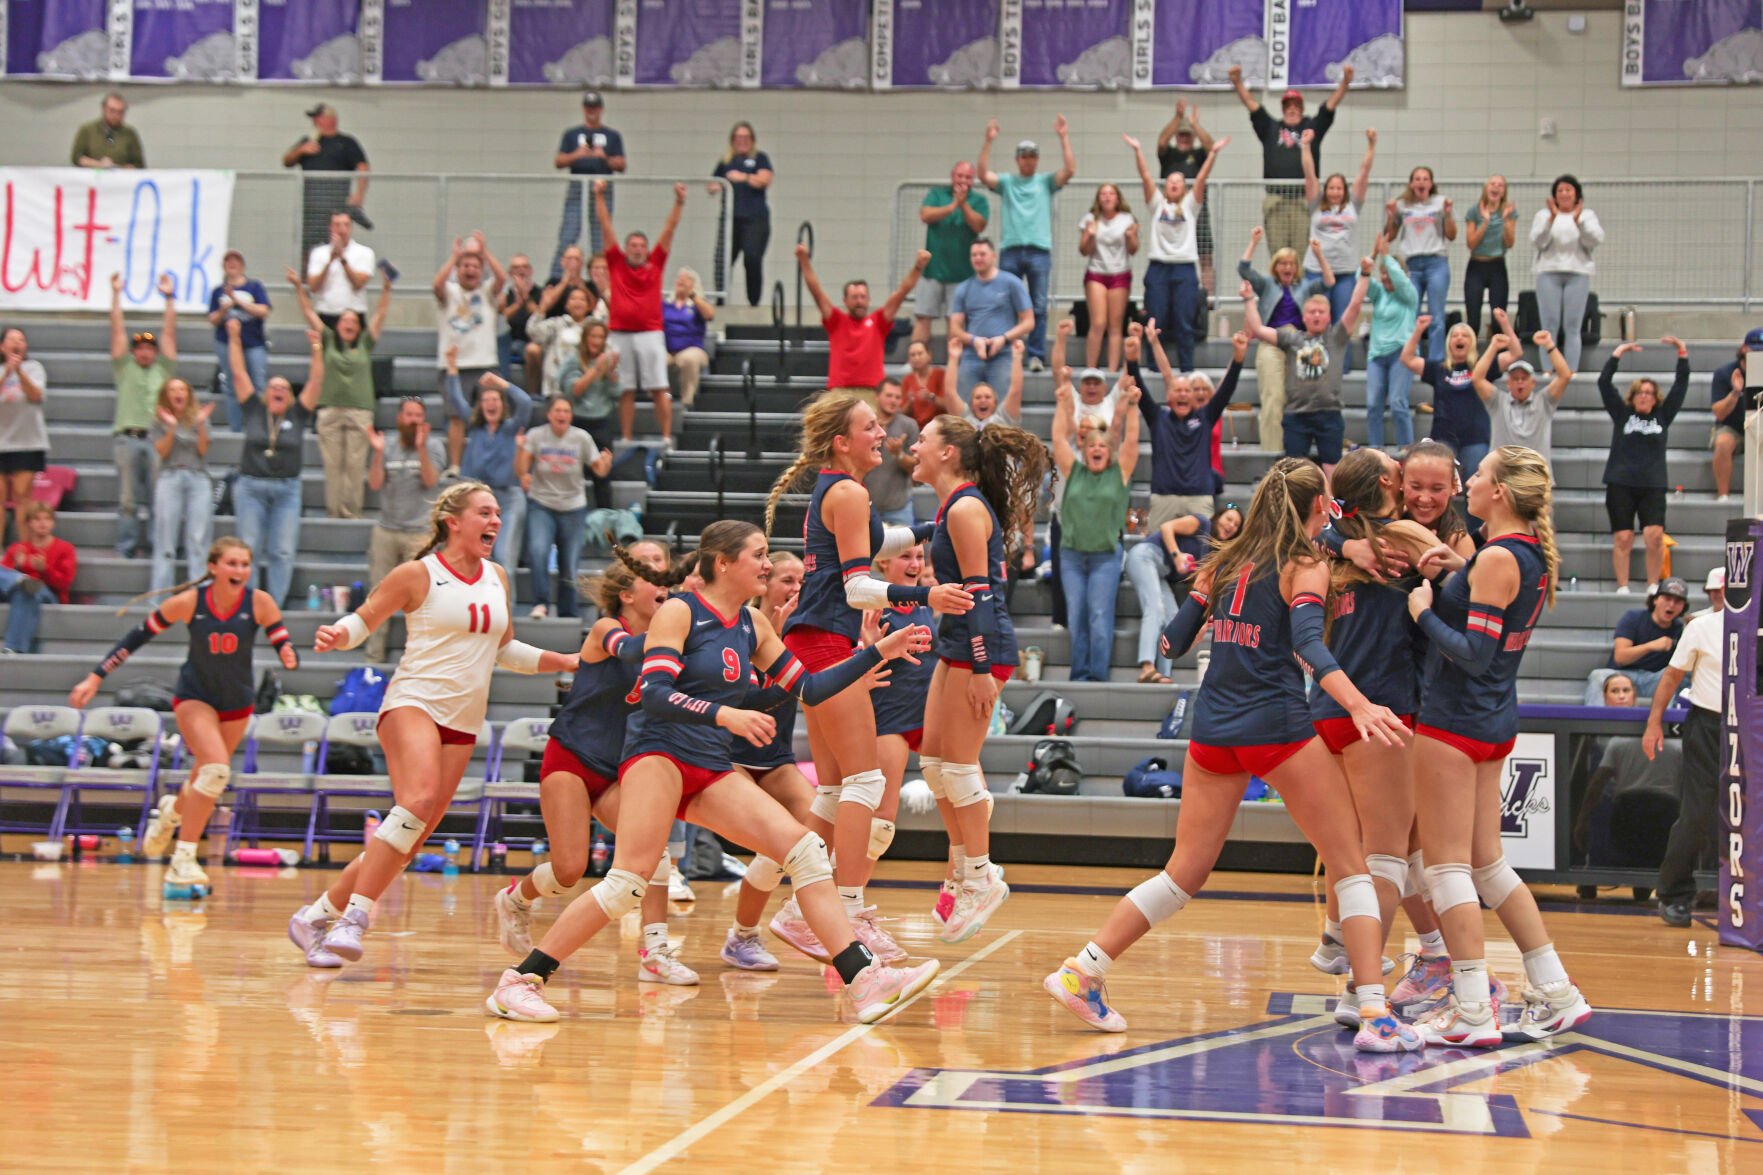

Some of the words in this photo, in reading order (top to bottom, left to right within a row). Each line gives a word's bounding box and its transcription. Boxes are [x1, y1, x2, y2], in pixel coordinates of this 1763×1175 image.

[241, 14, 253, 72] GIRLS
[618, 27, 632, 76] BOYS
[745, 27, 758, 79] GIRLS
[1004, 27, 1018, 78] BOYS
[1135, 20, 1149, 78] GIRLS
[1624, 24, 1640, 75] BOYS
[1229, 562, 1255, 616] 1
[1727, 541, 1754, 588] W
[208, 632, 238, 654] 10
[468, 602, 491, 634] 11
[722, 647, 741, 682] 9
[1726, 632, 1745, 929] RAZORS
